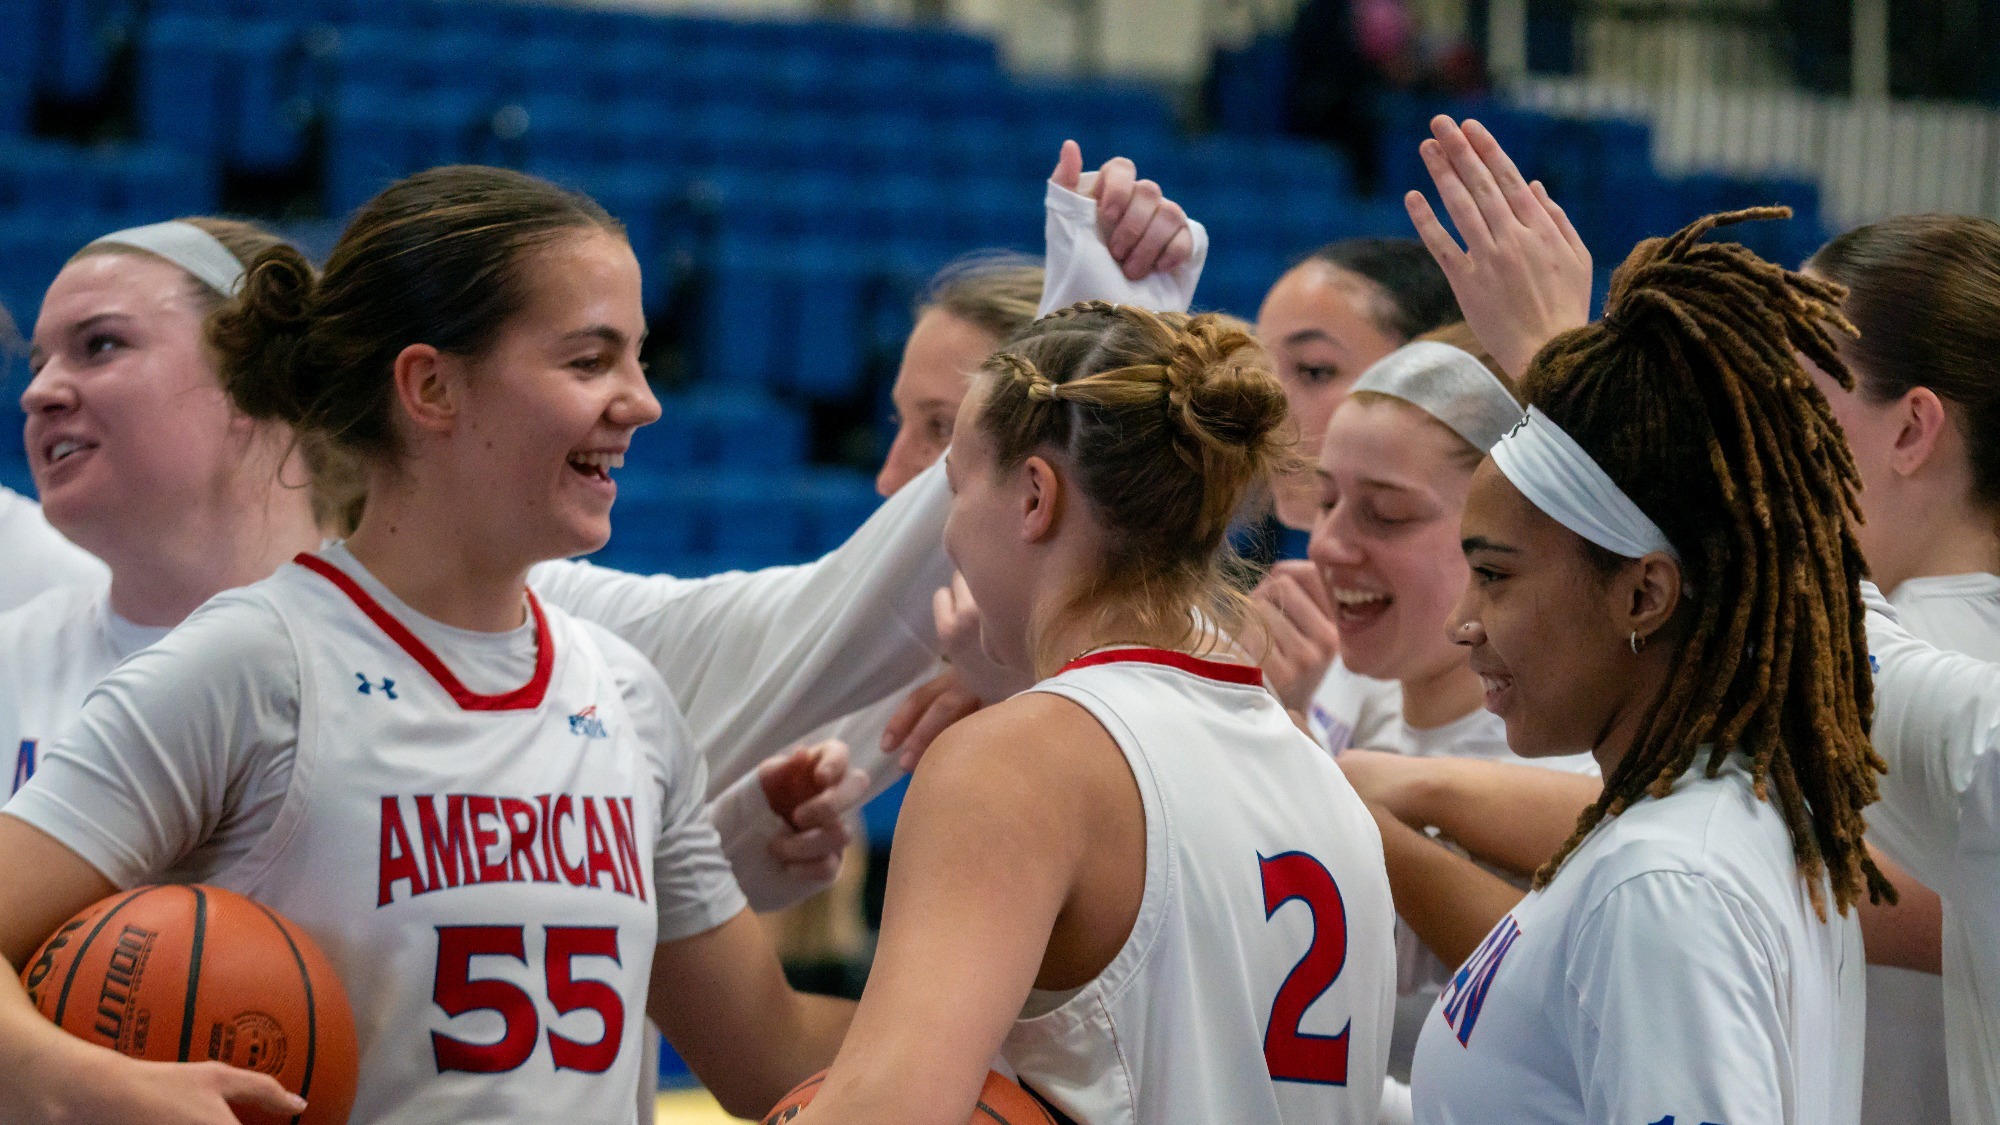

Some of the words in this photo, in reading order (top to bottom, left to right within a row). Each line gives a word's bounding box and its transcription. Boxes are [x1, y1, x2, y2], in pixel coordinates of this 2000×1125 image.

[377, 793, 647, 909] AMERICAN
[94, 925, 147, 1051] UTION
[431, 923, 625, 1074] 55
[1256, 850, 1351, 1086] 2
